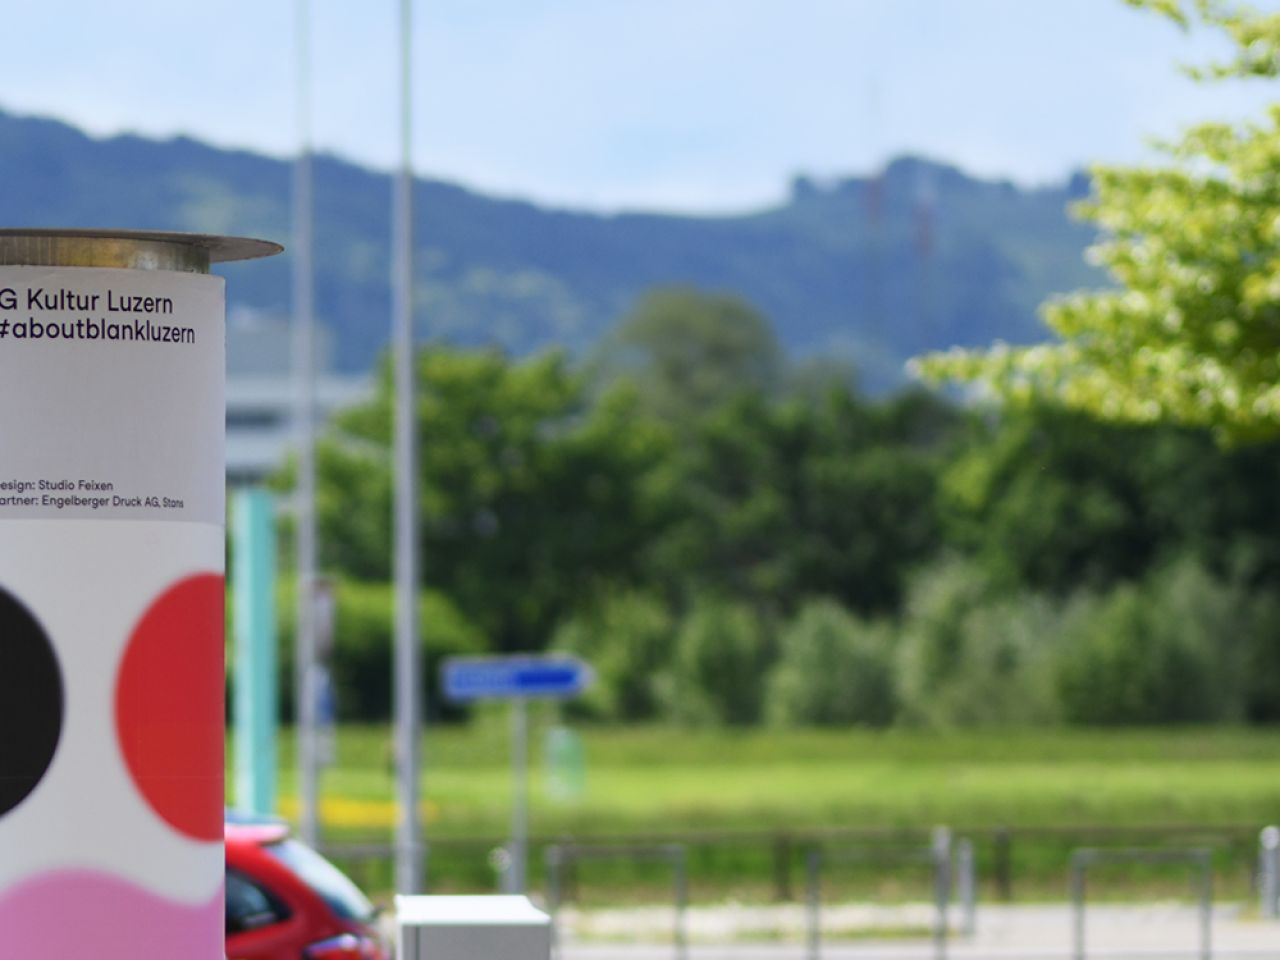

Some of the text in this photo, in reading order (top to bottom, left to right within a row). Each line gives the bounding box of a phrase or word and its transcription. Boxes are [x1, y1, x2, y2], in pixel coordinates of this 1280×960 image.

[27, 288, 100, 311] Kultur
[107, 290, 173, 314] Luzern
[38, 480, 75, 490] Studio
[78, 480, 113, 491] Feixen
[41, 495, 110, 509] Engelberger
[112, 495, 142, 507] Druck
[144, 496, 161, 508] AG,
